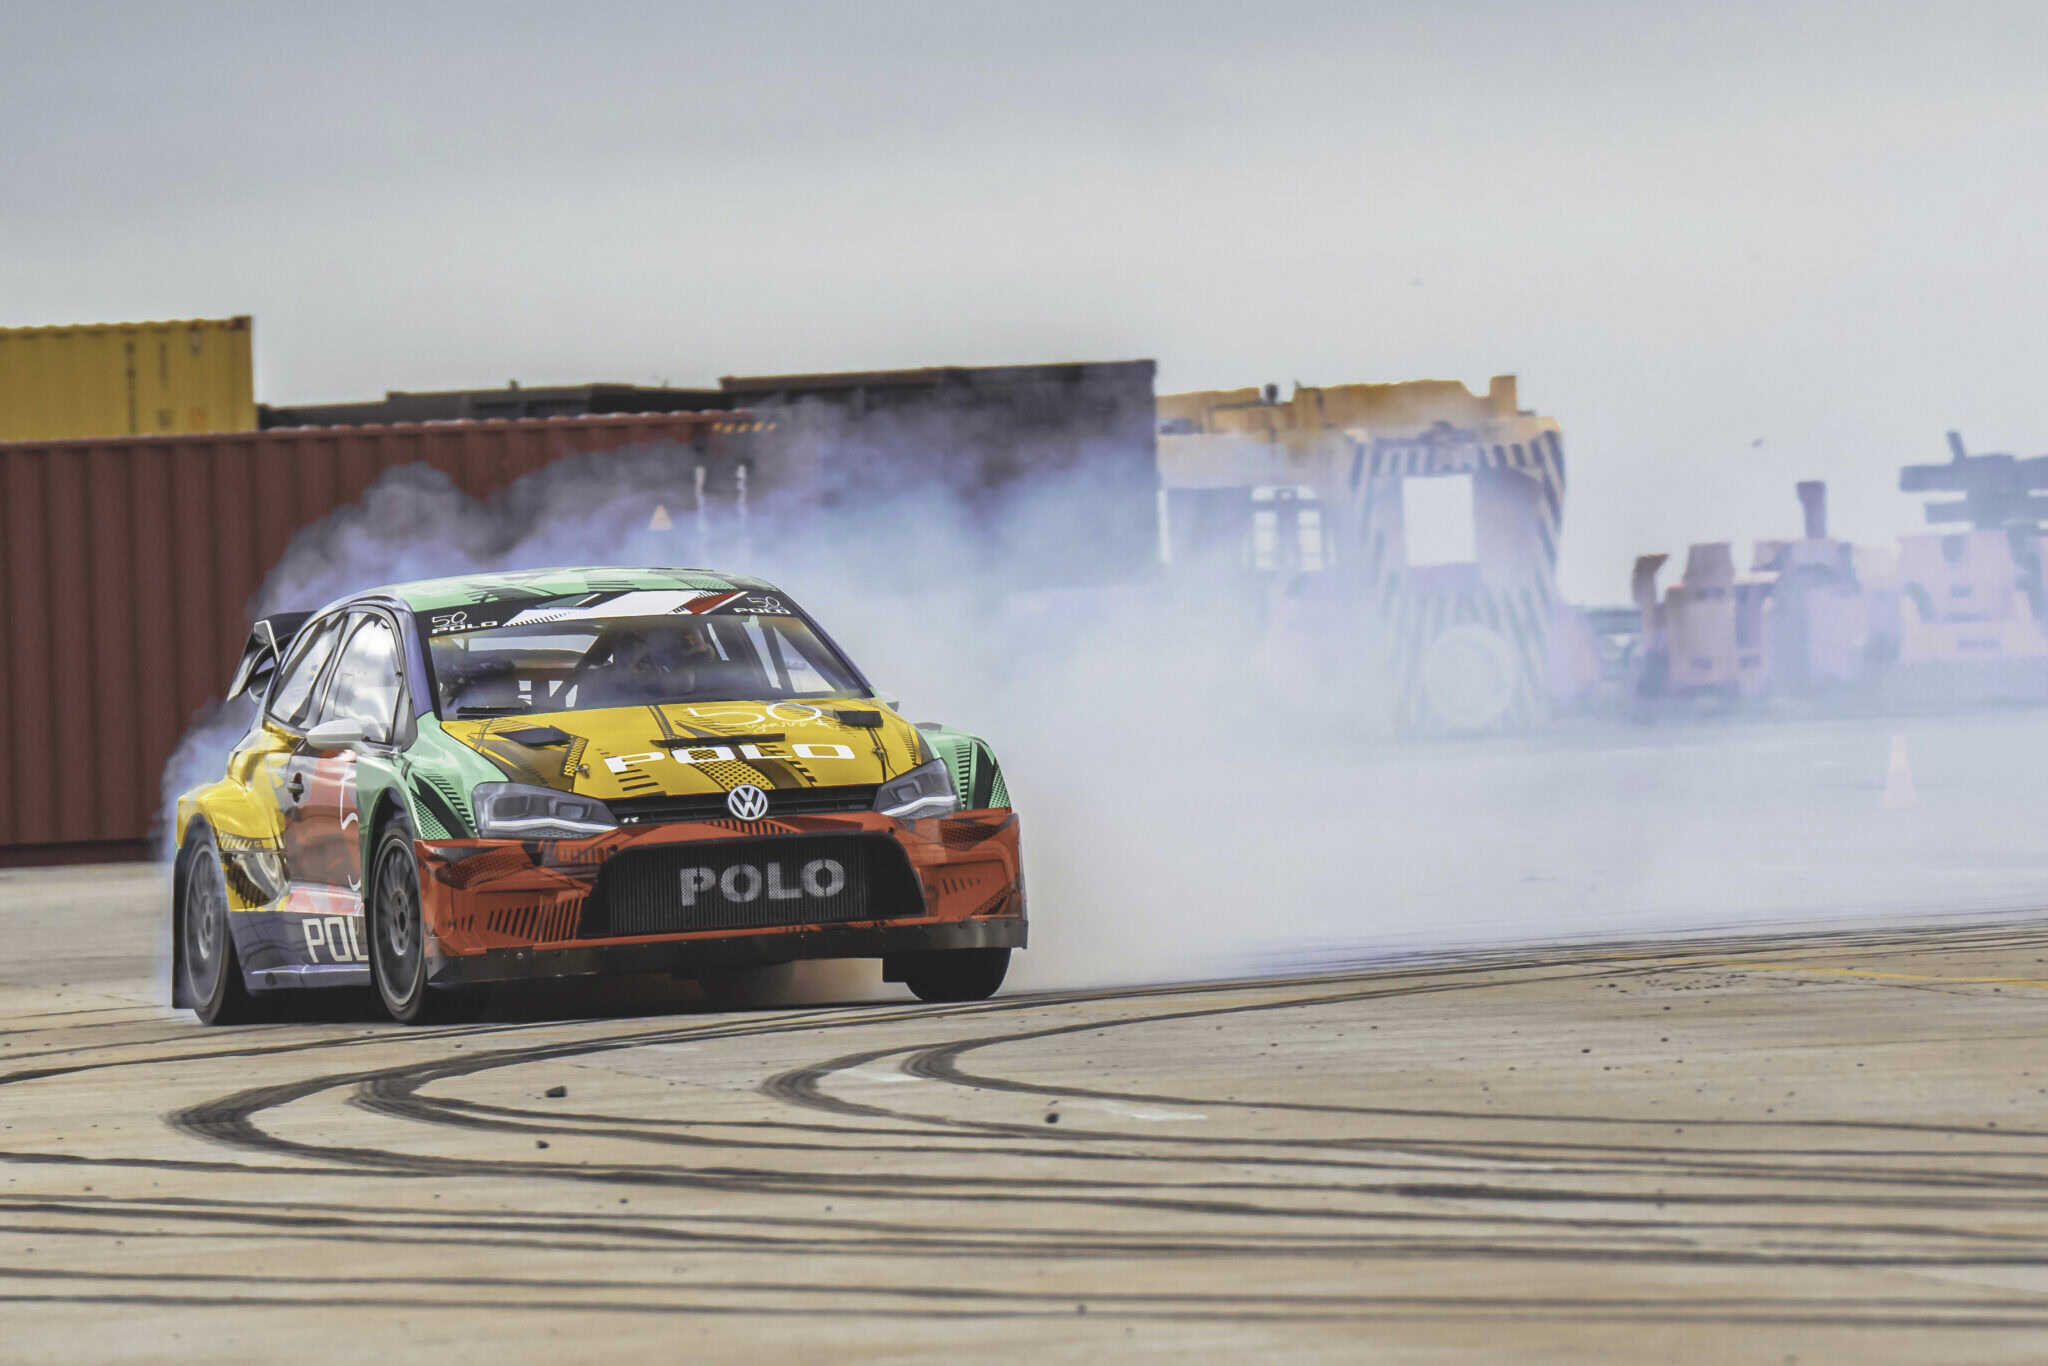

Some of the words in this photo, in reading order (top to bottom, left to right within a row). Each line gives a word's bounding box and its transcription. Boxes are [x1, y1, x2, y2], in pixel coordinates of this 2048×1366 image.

[431, 621, 498, 633] POLO
[687, 702, 823, 726] 50
[604, 744, 856, 773] POLO
[680, 859, 845, 907] POLO
